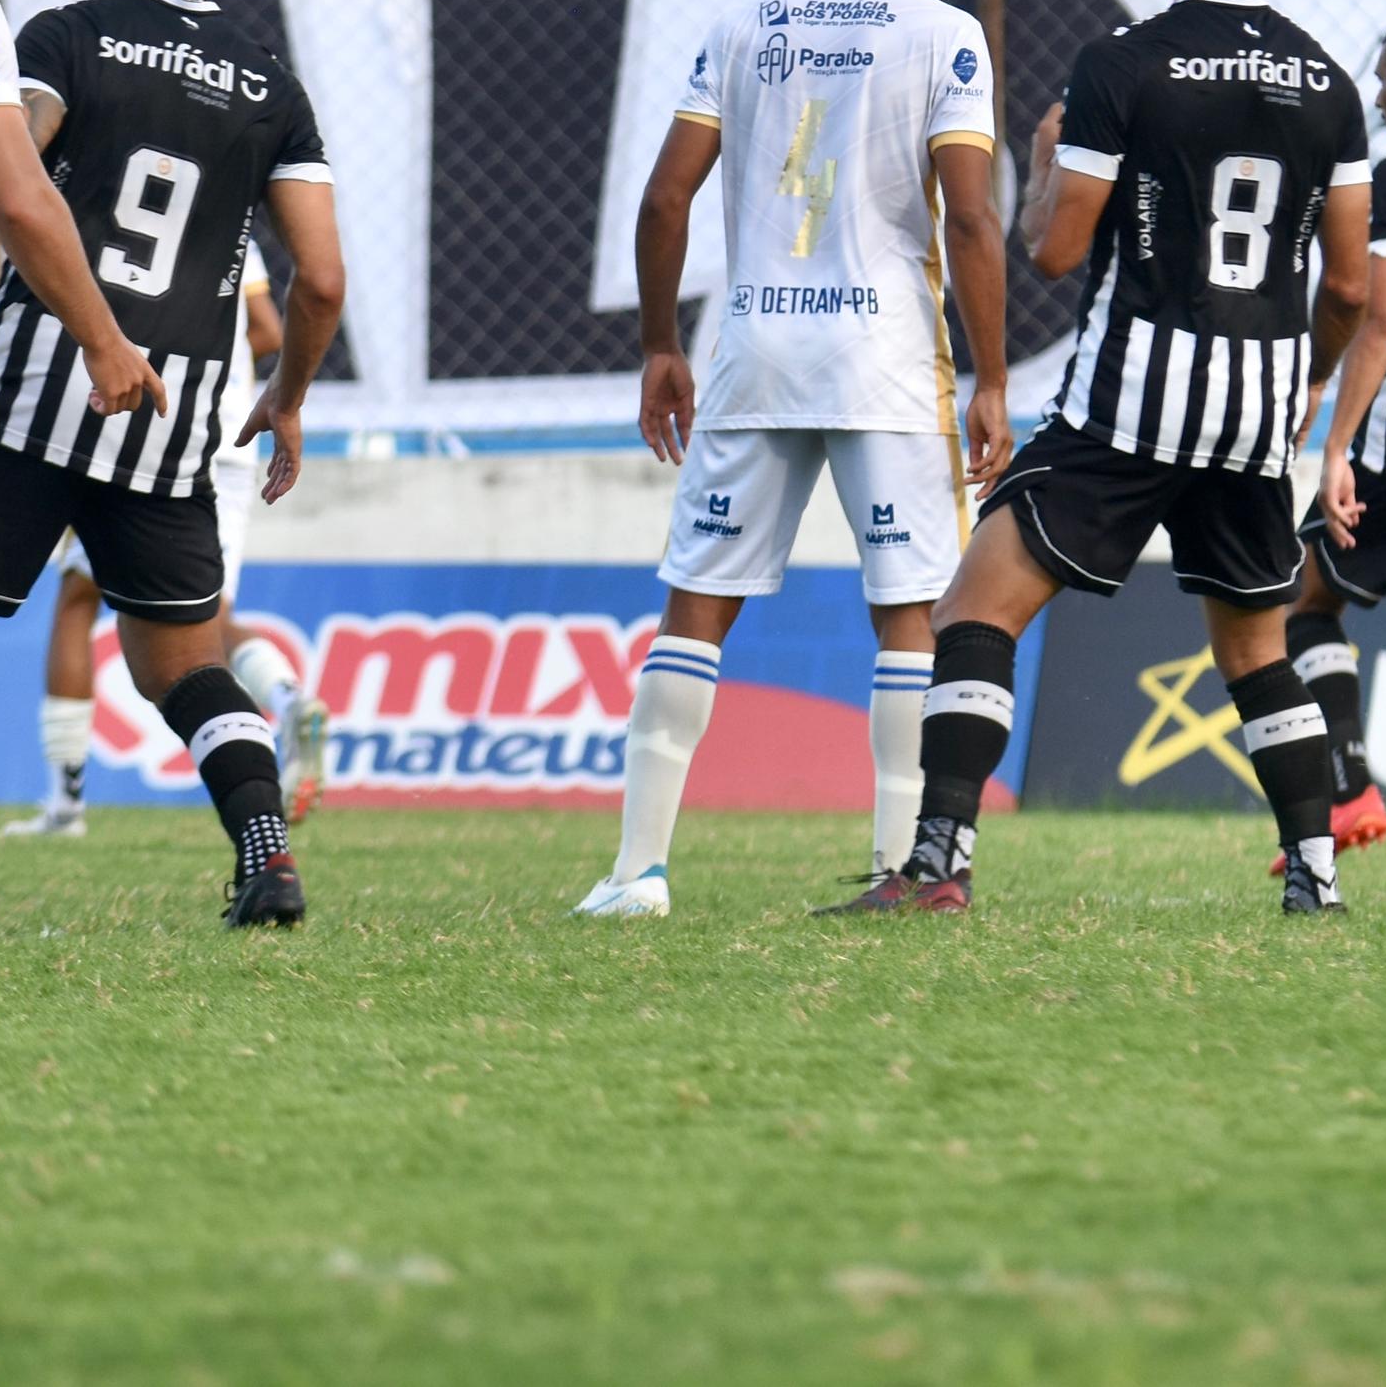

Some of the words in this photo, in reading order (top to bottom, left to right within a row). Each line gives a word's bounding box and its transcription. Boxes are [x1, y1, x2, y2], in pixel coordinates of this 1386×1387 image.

[790, 7, 826, 19] DOS
[829, 9, 897, 23] POBRES
[98, 35, 235, 93] sorrifácil
[799, 47, 874, 67] Paraíba
[1169, 49, 1302, 89] sorrifácil
[775, 98, 838, 258] 4
[98, 148, 201, 297] 9
[1208, 156, 1282, 290] 8
[761, 286, 879, 315] DETRAN-PB
[693, 518, 744, 536] MARTINS
[327, 723, 628, 777] mateus
